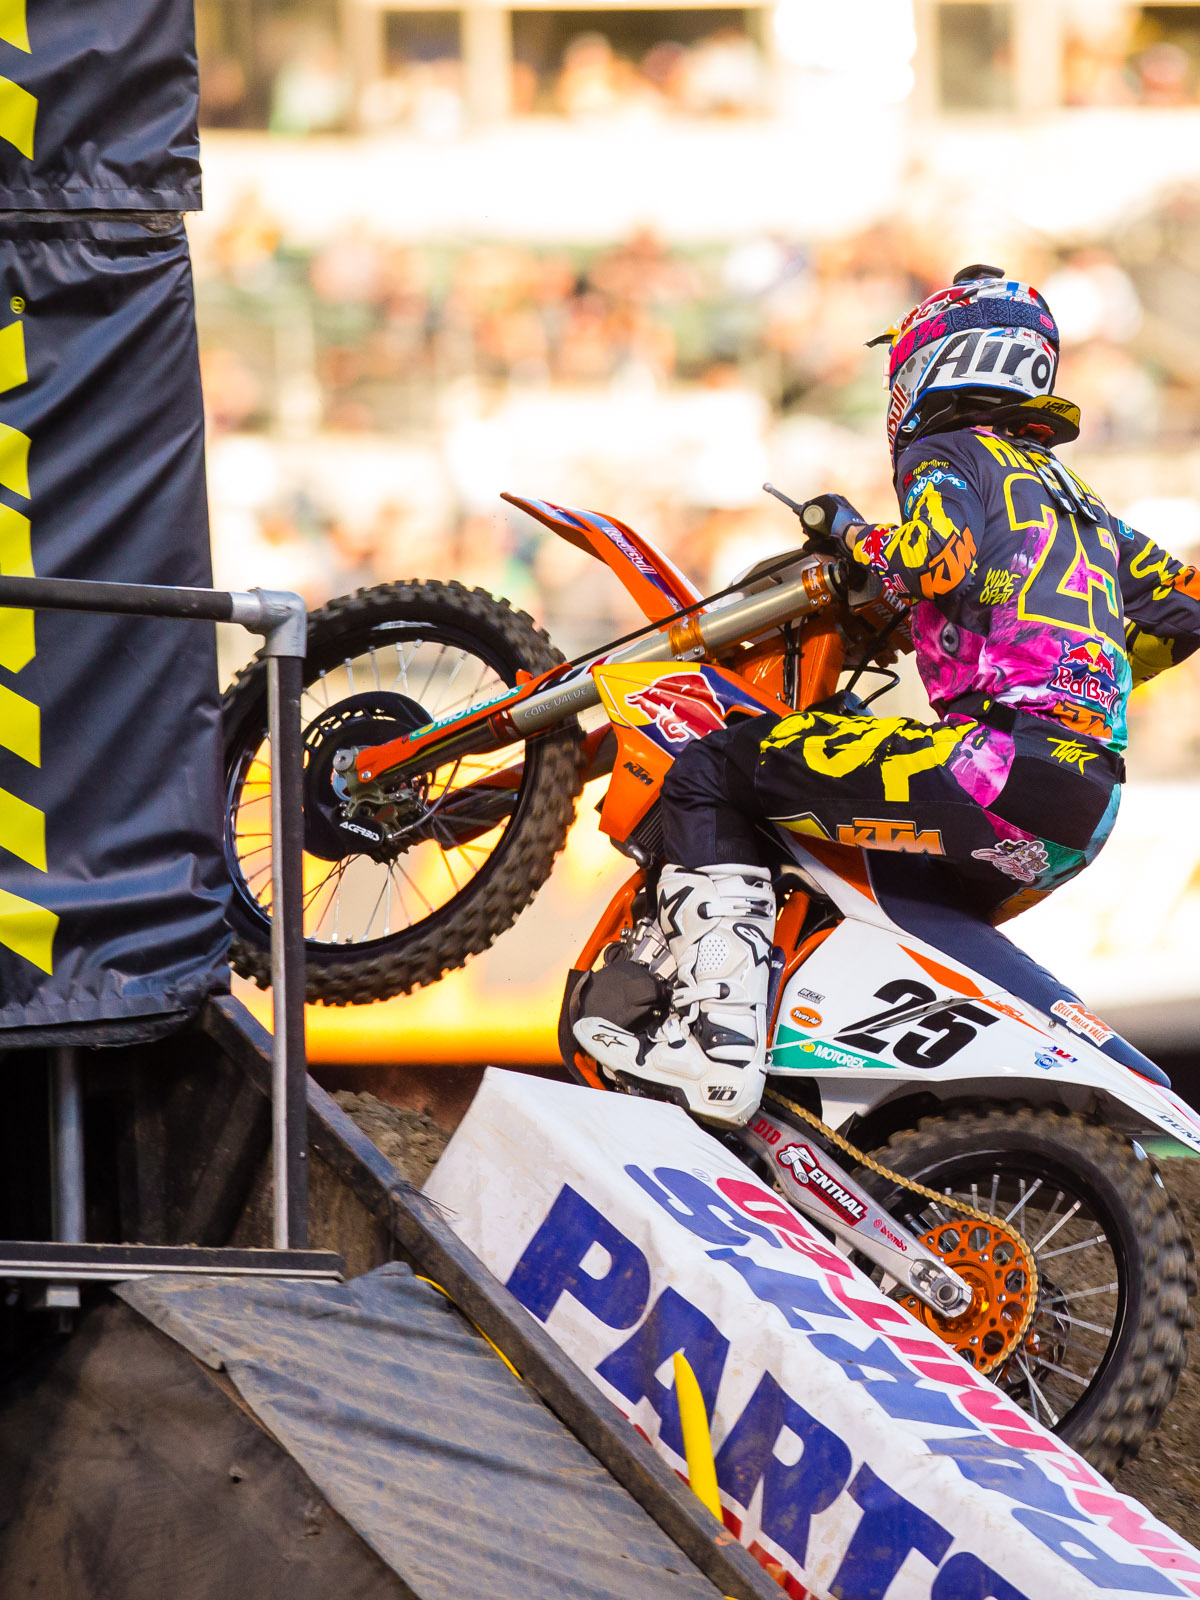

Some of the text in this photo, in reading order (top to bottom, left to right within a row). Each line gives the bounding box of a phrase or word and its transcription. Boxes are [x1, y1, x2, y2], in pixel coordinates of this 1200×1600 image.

[915, 332, 1051, 389] Airo
[920, 526, 978, 600] KTM
[984, 567, 1022, 591] WIDE
[1050, 665, 1120, 714] Red Bull
[623, 761, 655, 787] KTM
[838, 819, 946, 855] KTM
[791, 1009, 821, 1026] Twin Air
[833, 979, 1000, 1068] 25
[1053, 1002, 1108, 1042] SELLE DALLA VALLE
[814, 1044, 869, 1068] MOTOREX
[778, 1145, 863, 1218] RENTHAL
